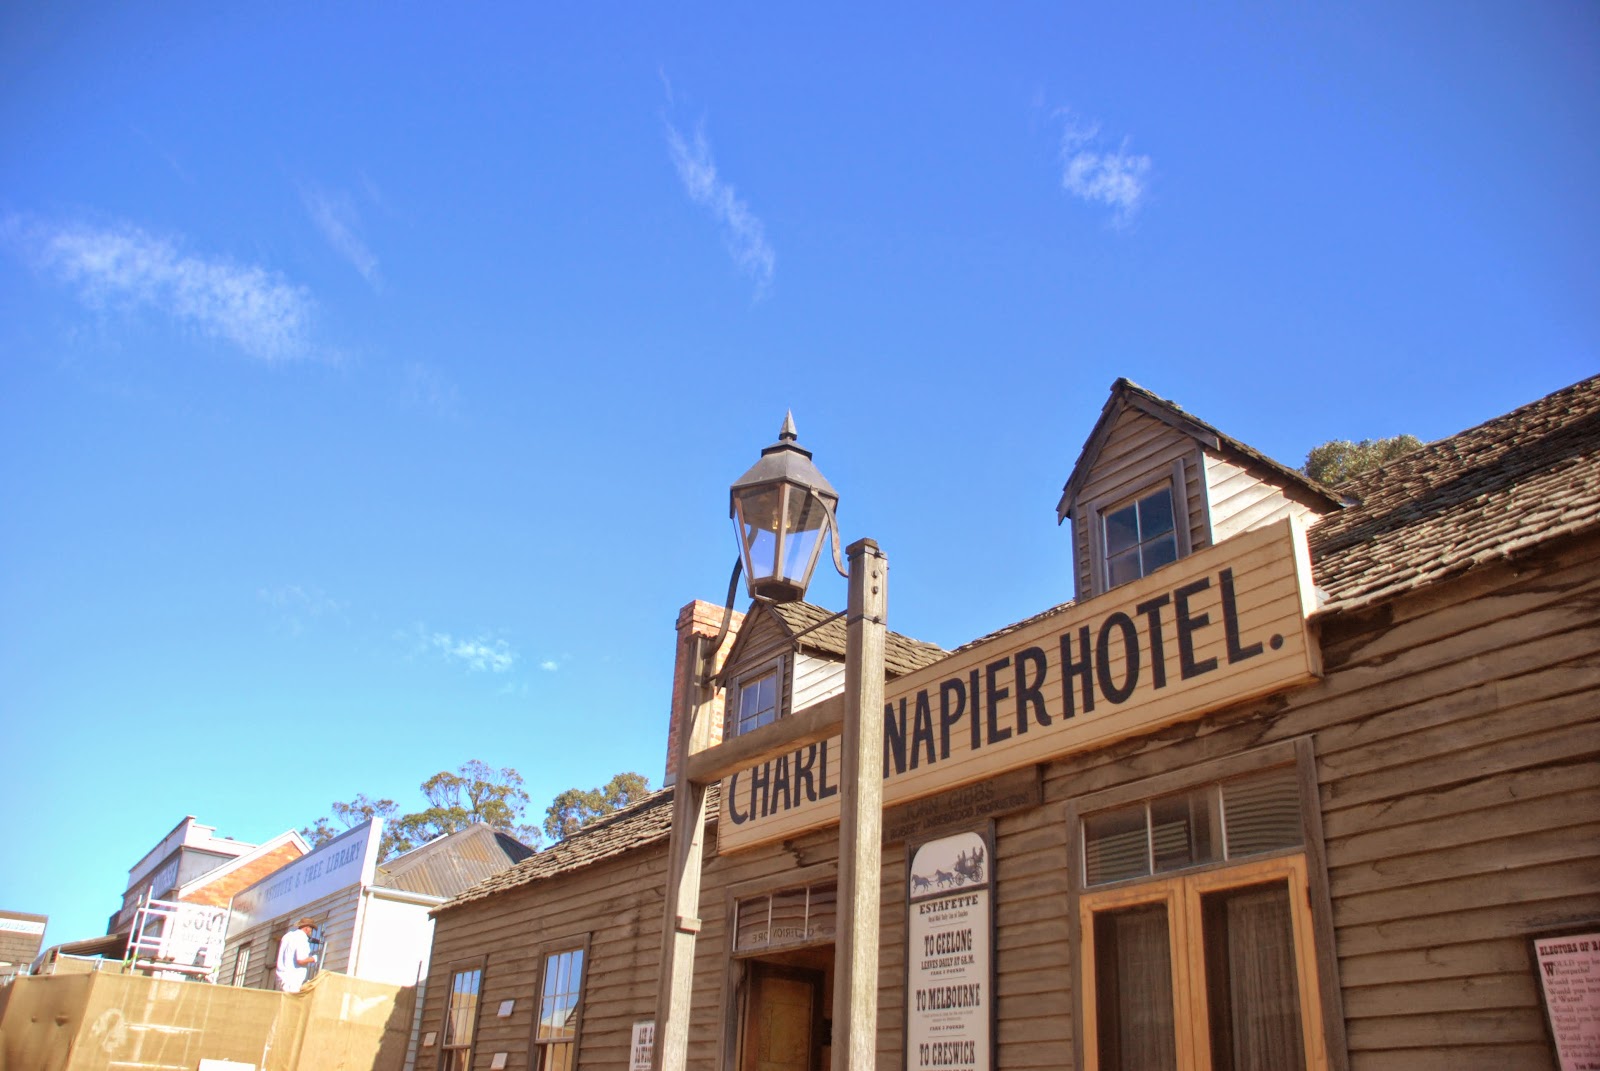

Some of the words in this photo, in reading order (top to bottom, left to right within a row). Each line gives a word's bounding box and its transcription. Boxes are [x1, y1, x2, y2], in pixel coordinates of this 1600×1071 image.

[729, 740, 841, 825] CHARL
[883, 646, 1052, 779] NAPIER
[1060, 567, 1285, 721] HOTEL.
[303, 861, 323, 885] FREE
[325, 841, 363, 874] LIBRARY
[919, 894, 979, 915] ESTAFETTE
[924, 934, 934, 957] TO
[936, 928, 972, 956] GEELONG
[1539, 943, 1578, 956] ELECTORS
[1579, 941, 1590, 952] OF
[921, 958, 939, 970] LEAVES
[939, 956, 953, 968] DAILY
[953, 955, 961, 966] AT
[916, 989, 926, 1012] TO
[928, 982, 981, 1011] MELBOURNE
[919, 1042, 929, 1067] TO
[932, 1040, 976, 1066] CRESWICK
